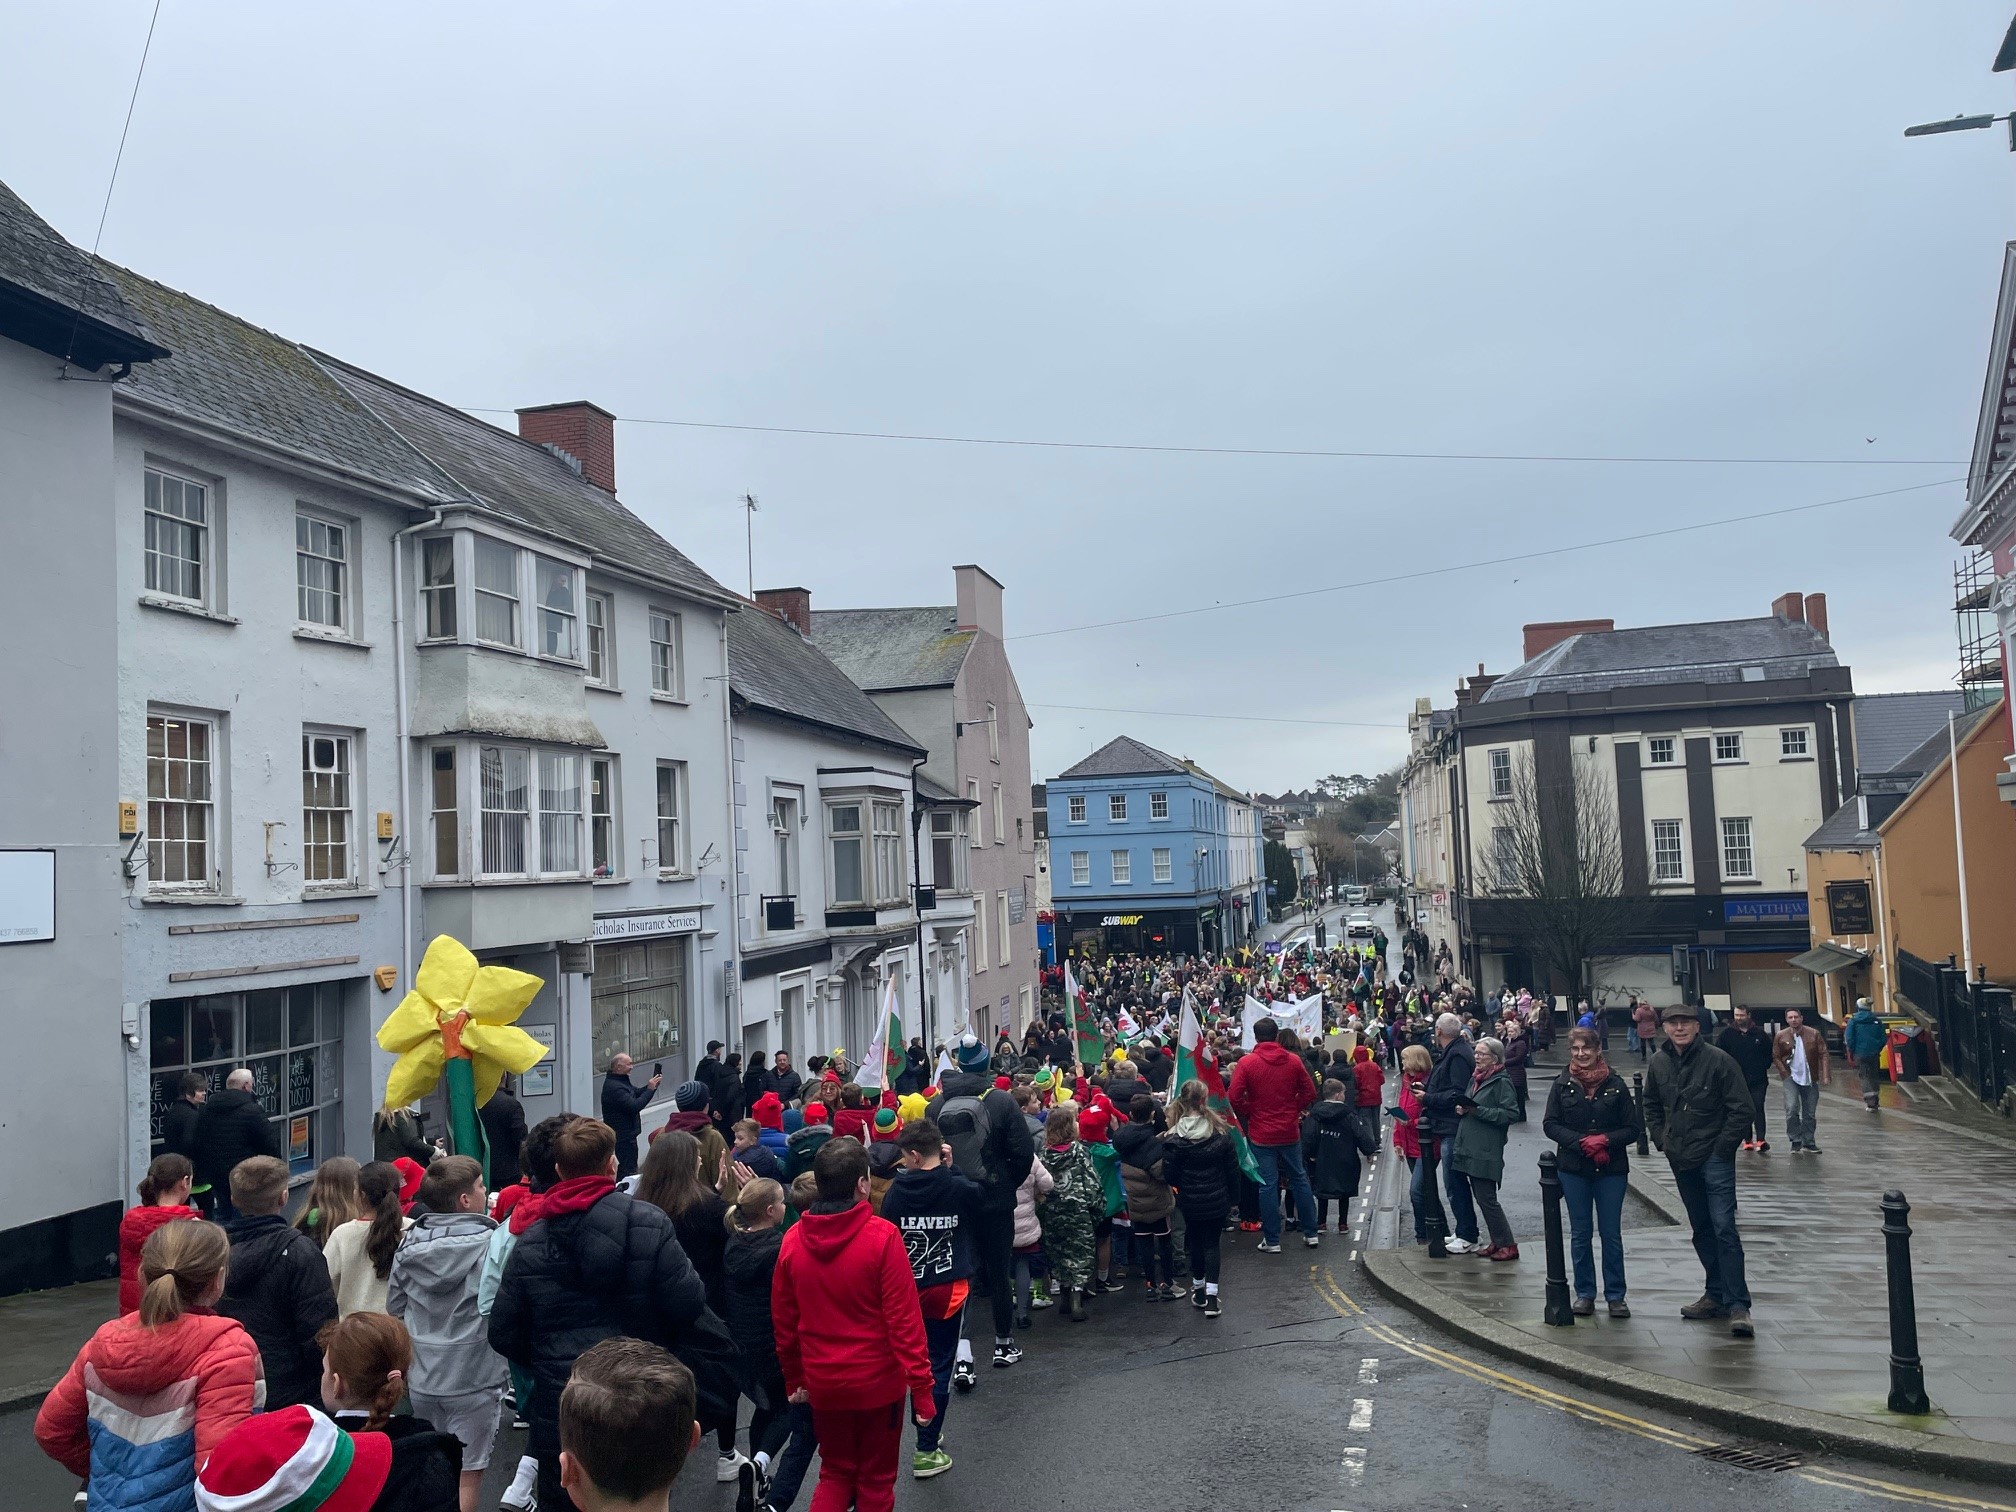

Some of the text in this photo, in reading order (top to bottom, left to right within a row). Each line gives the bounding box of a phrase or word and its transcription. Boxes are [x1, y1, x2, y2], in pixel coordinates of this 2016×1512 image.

[628, 918, 666, 933] Insurance
[667, 915, 697, 929] Services
[1100, 914, 1144, 927] SUBWAY
[529, 1030, 552, 1038] cholas
[253, 1061, 268, 1076] WE
[290, 1074, 311, 1089] NOW
[150, 1101, 174, 1115] OW
[900, 1214, 959, 1230] LEAVERS
[901, 1230, 954, 1279] 24
